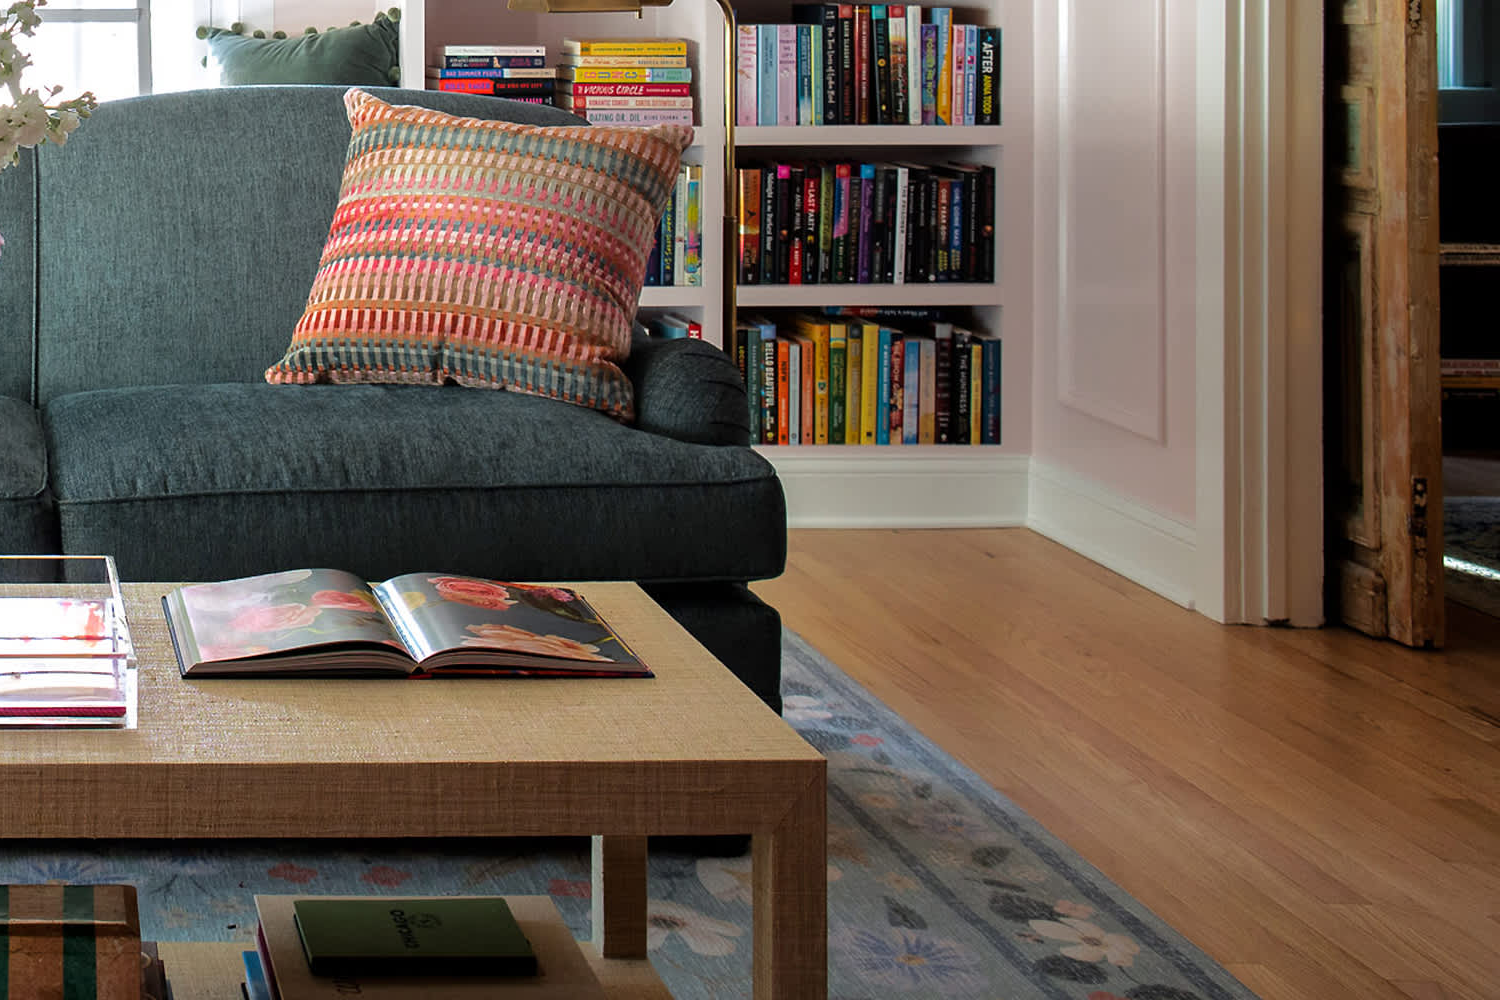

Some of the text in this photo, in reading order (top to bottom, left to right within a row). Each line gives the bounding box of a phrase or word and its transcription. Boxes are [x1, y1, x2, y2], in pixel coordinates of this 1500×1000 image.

[584, 86, 644, 94] VICIOUS CIRCLE
[982, 42, 993, 114] AFTER ANNA TODD
[765, 342, 774, 408] HELLO BEAUTIFUL
